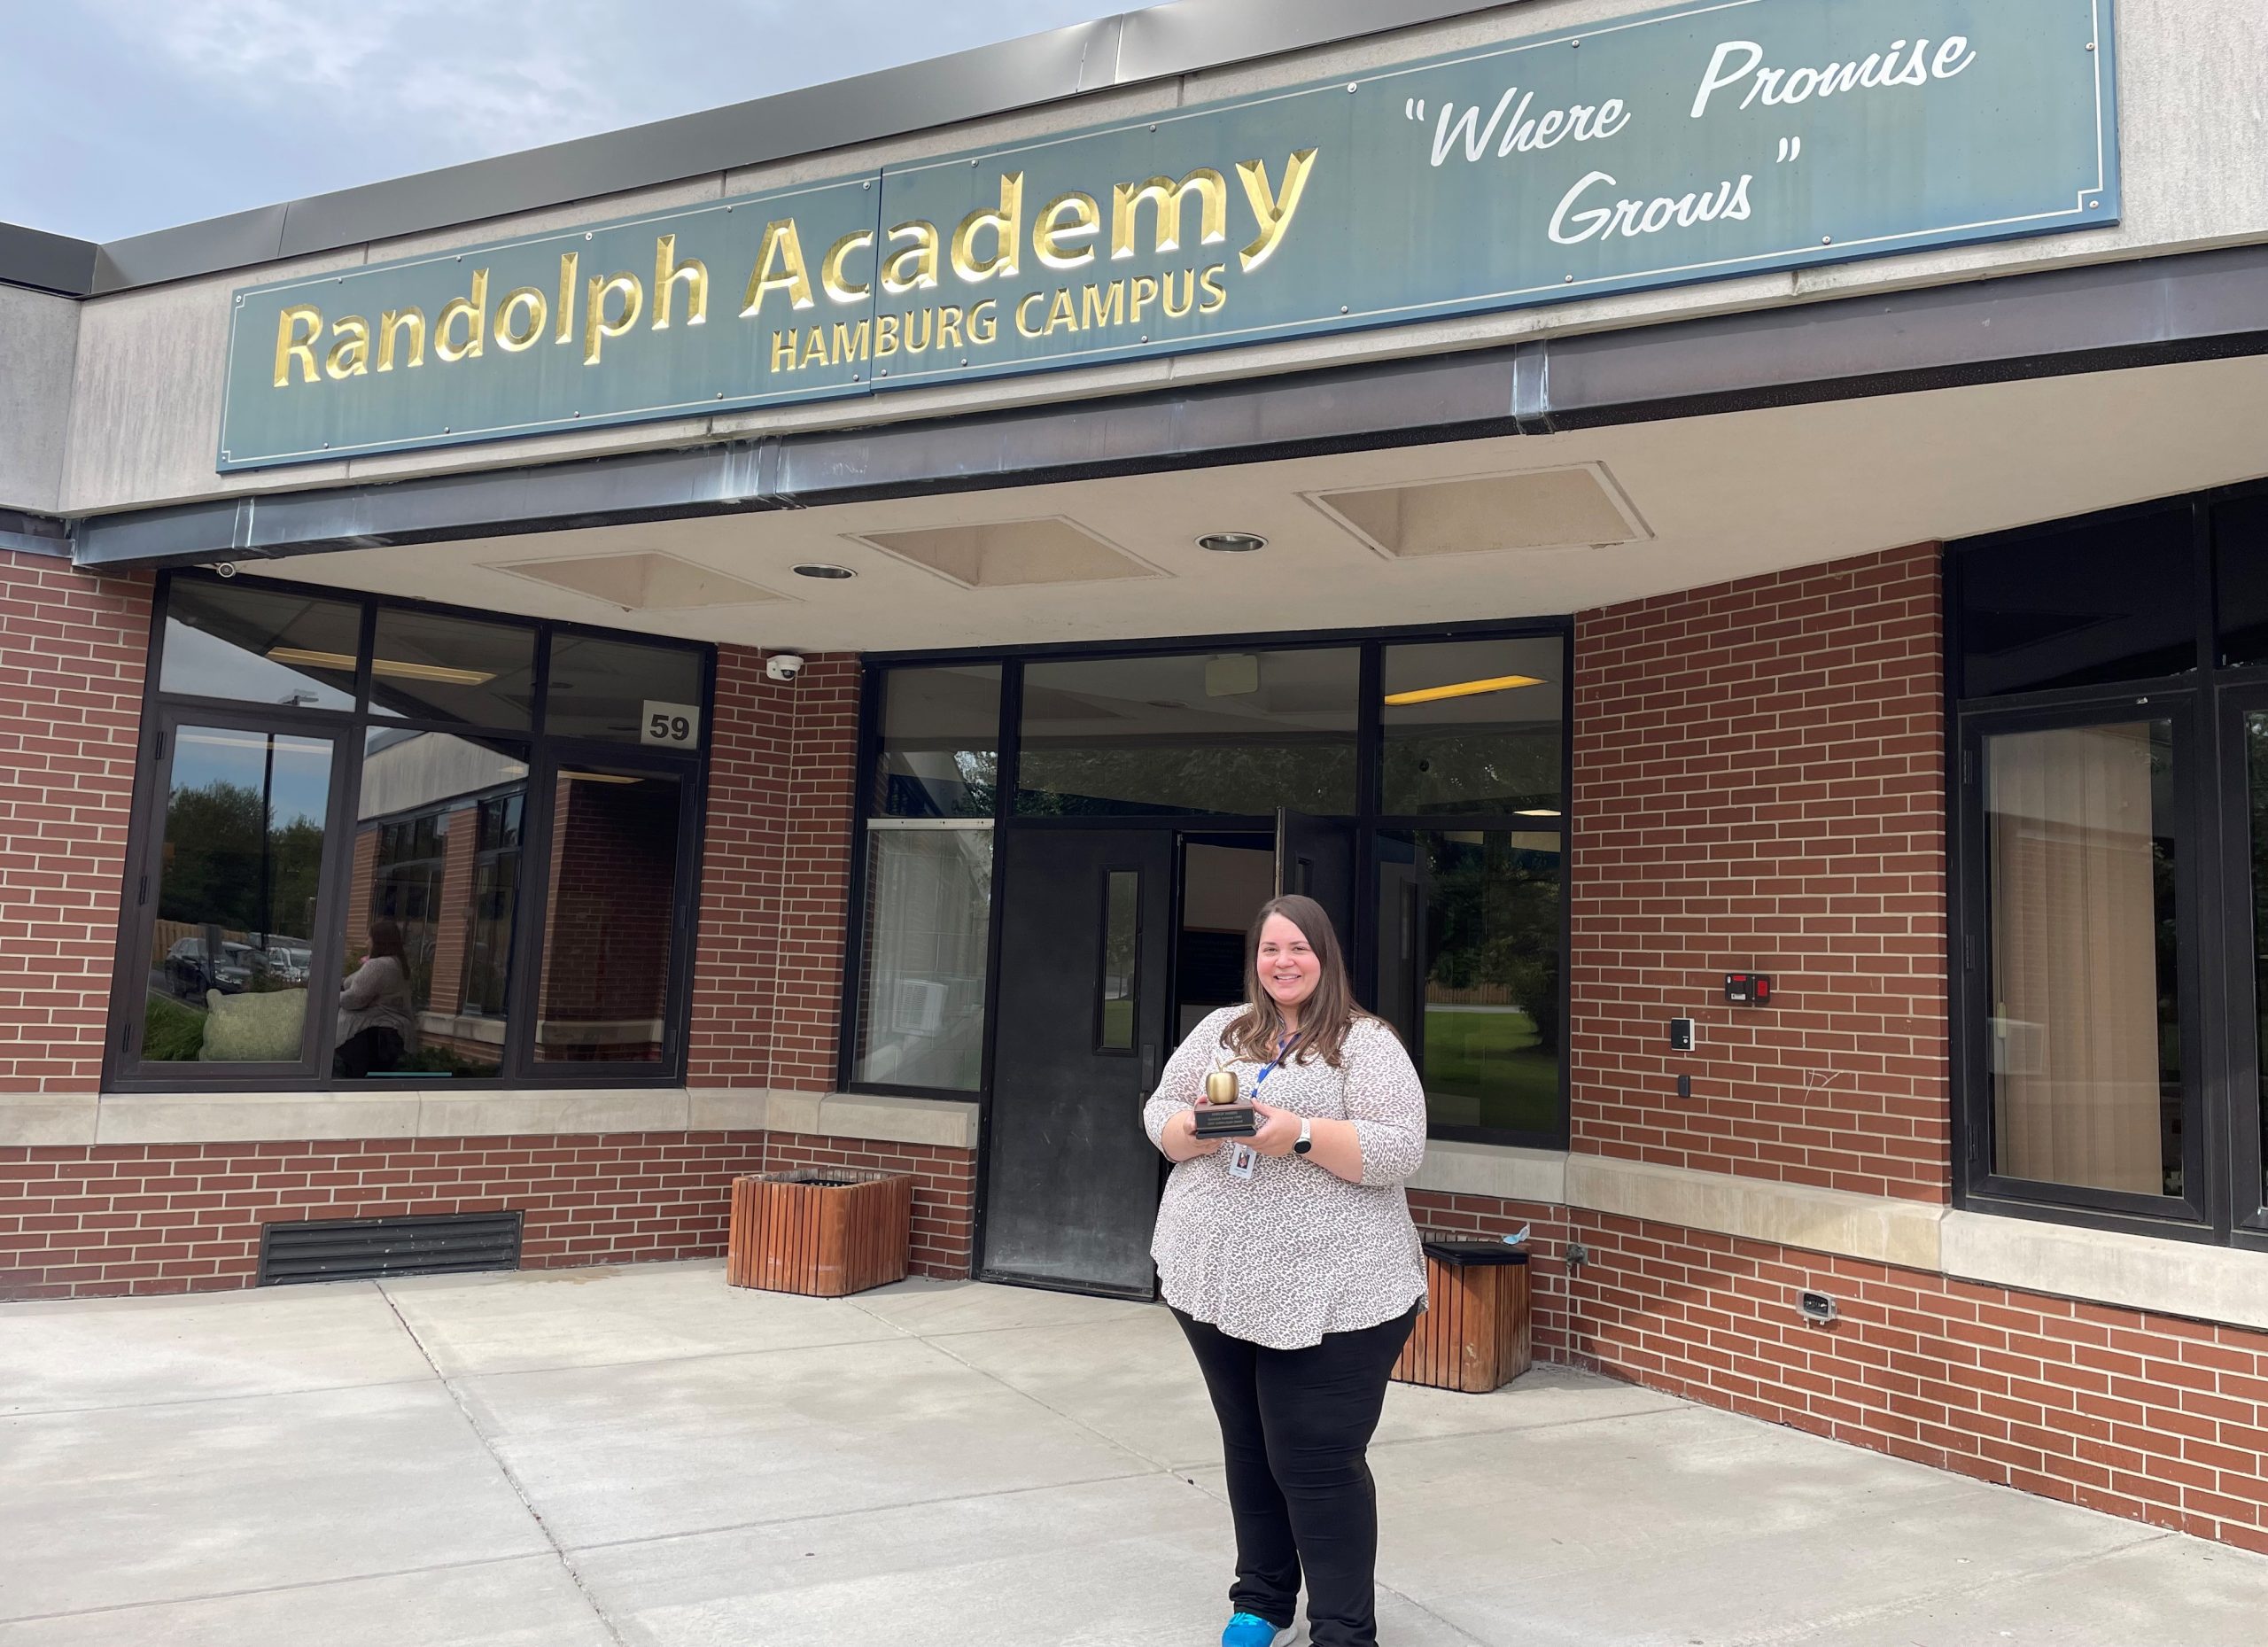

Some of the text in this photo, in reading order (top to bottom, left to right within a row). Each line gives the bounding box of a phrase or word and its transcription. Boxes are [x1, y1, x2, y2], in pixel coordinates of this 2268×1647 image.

[1689, 35, 1976, 119] Promise
[274, 146, 1318, 387] Randolph Academy
[771, 262, 1228, 373] HAMBURG CAMPUS
[649, 714, 690, 741] 59
